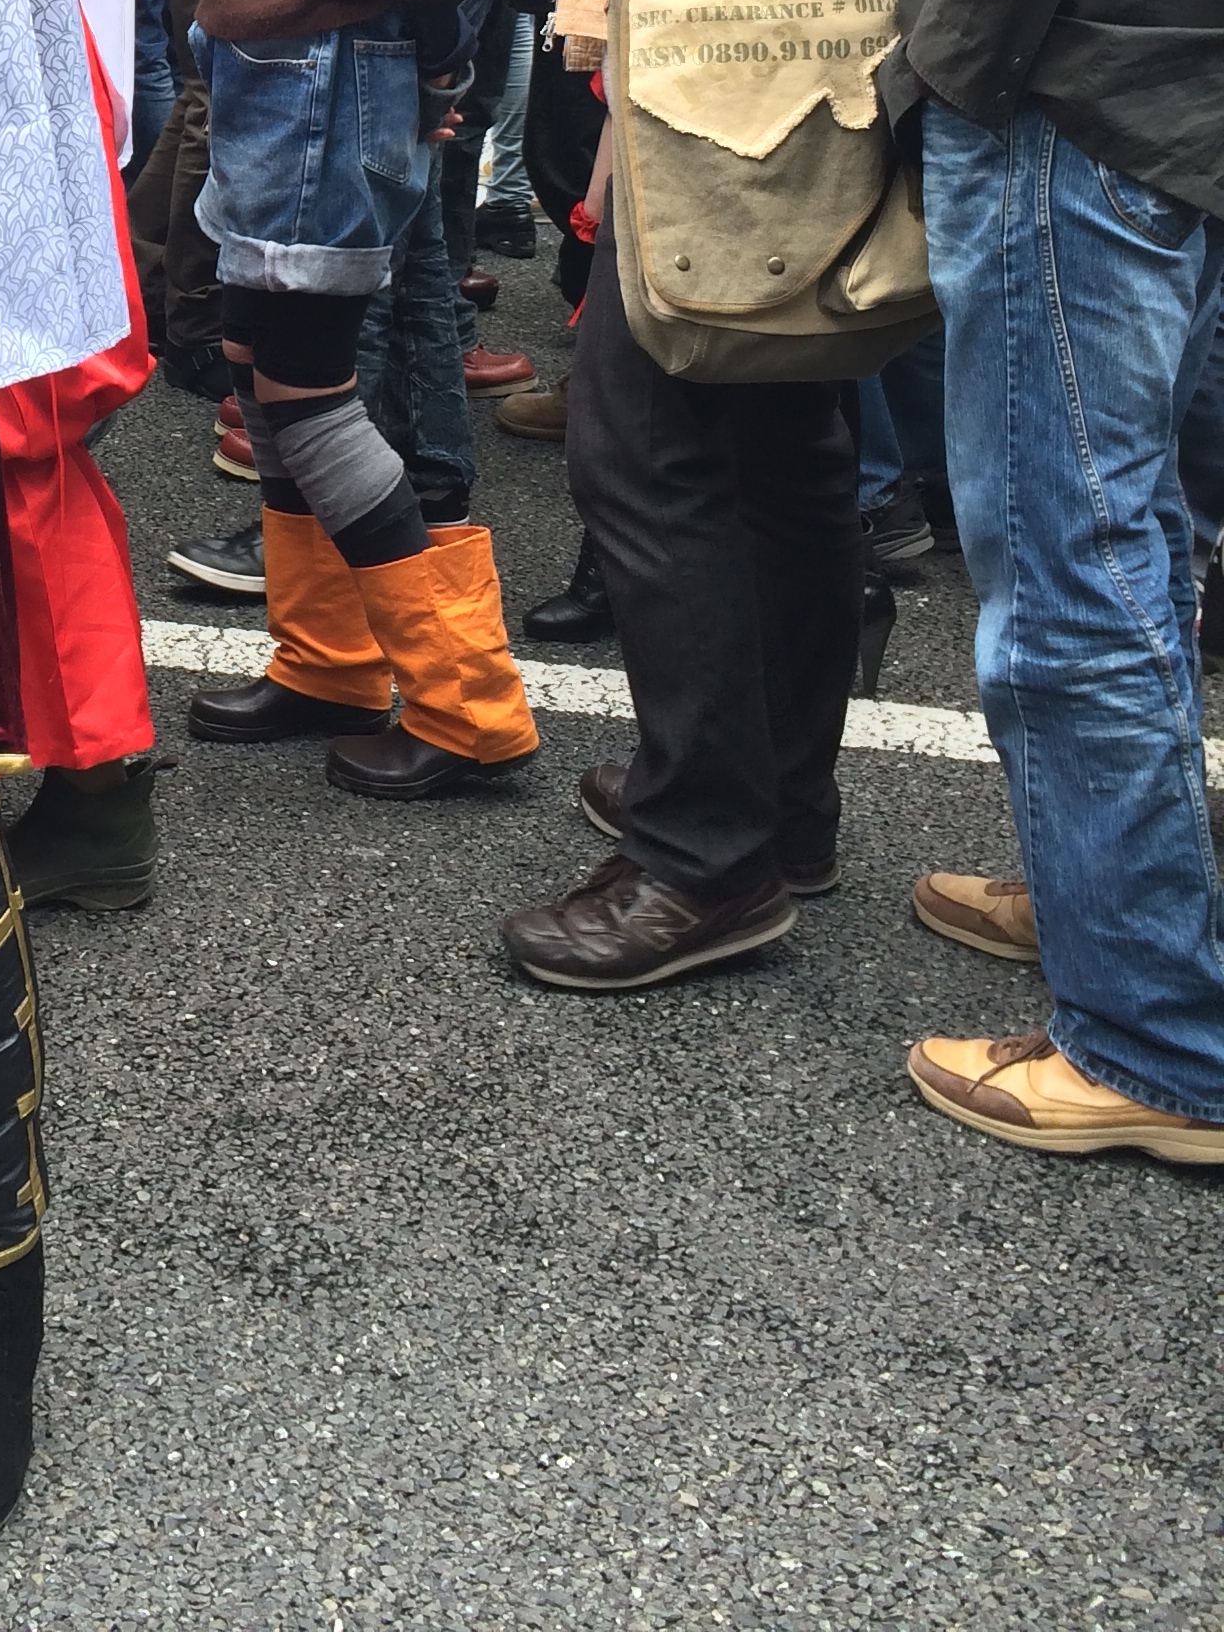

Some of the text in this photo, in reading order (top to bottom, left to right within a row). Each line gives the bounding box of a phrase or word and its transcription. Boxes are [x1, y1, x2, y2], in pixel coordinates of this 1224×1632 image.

[684, 2, 825, 23] CLEARANCE
[632, 45, 687, 68] NSN
[693, 38, 851, 65] 0890.9100
